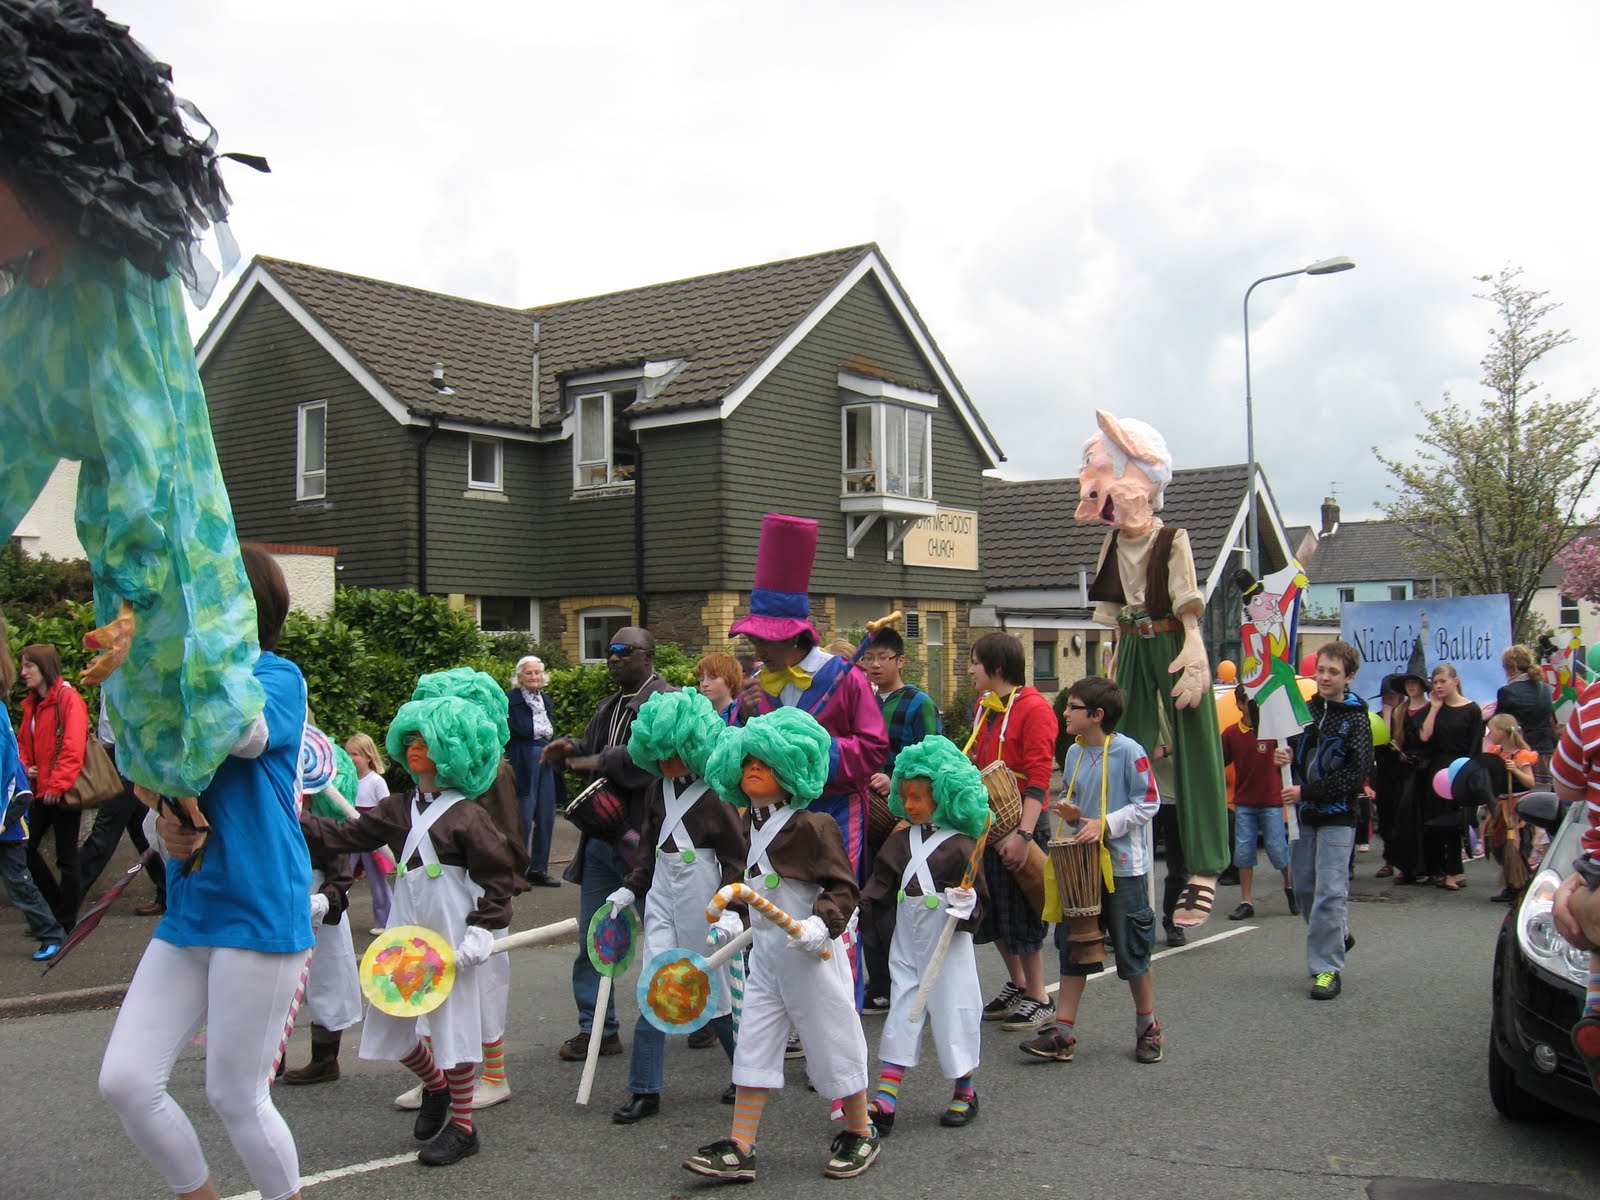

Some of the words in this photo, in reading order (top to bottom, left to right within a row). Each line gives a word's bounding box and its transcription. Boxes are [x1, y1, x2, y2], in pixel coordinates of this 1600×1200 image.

[933, 513, 972, 534] METHODIST
[928, 538, 955, 558] CHURCH
[1434, 626, 1492, 661] Ballet
